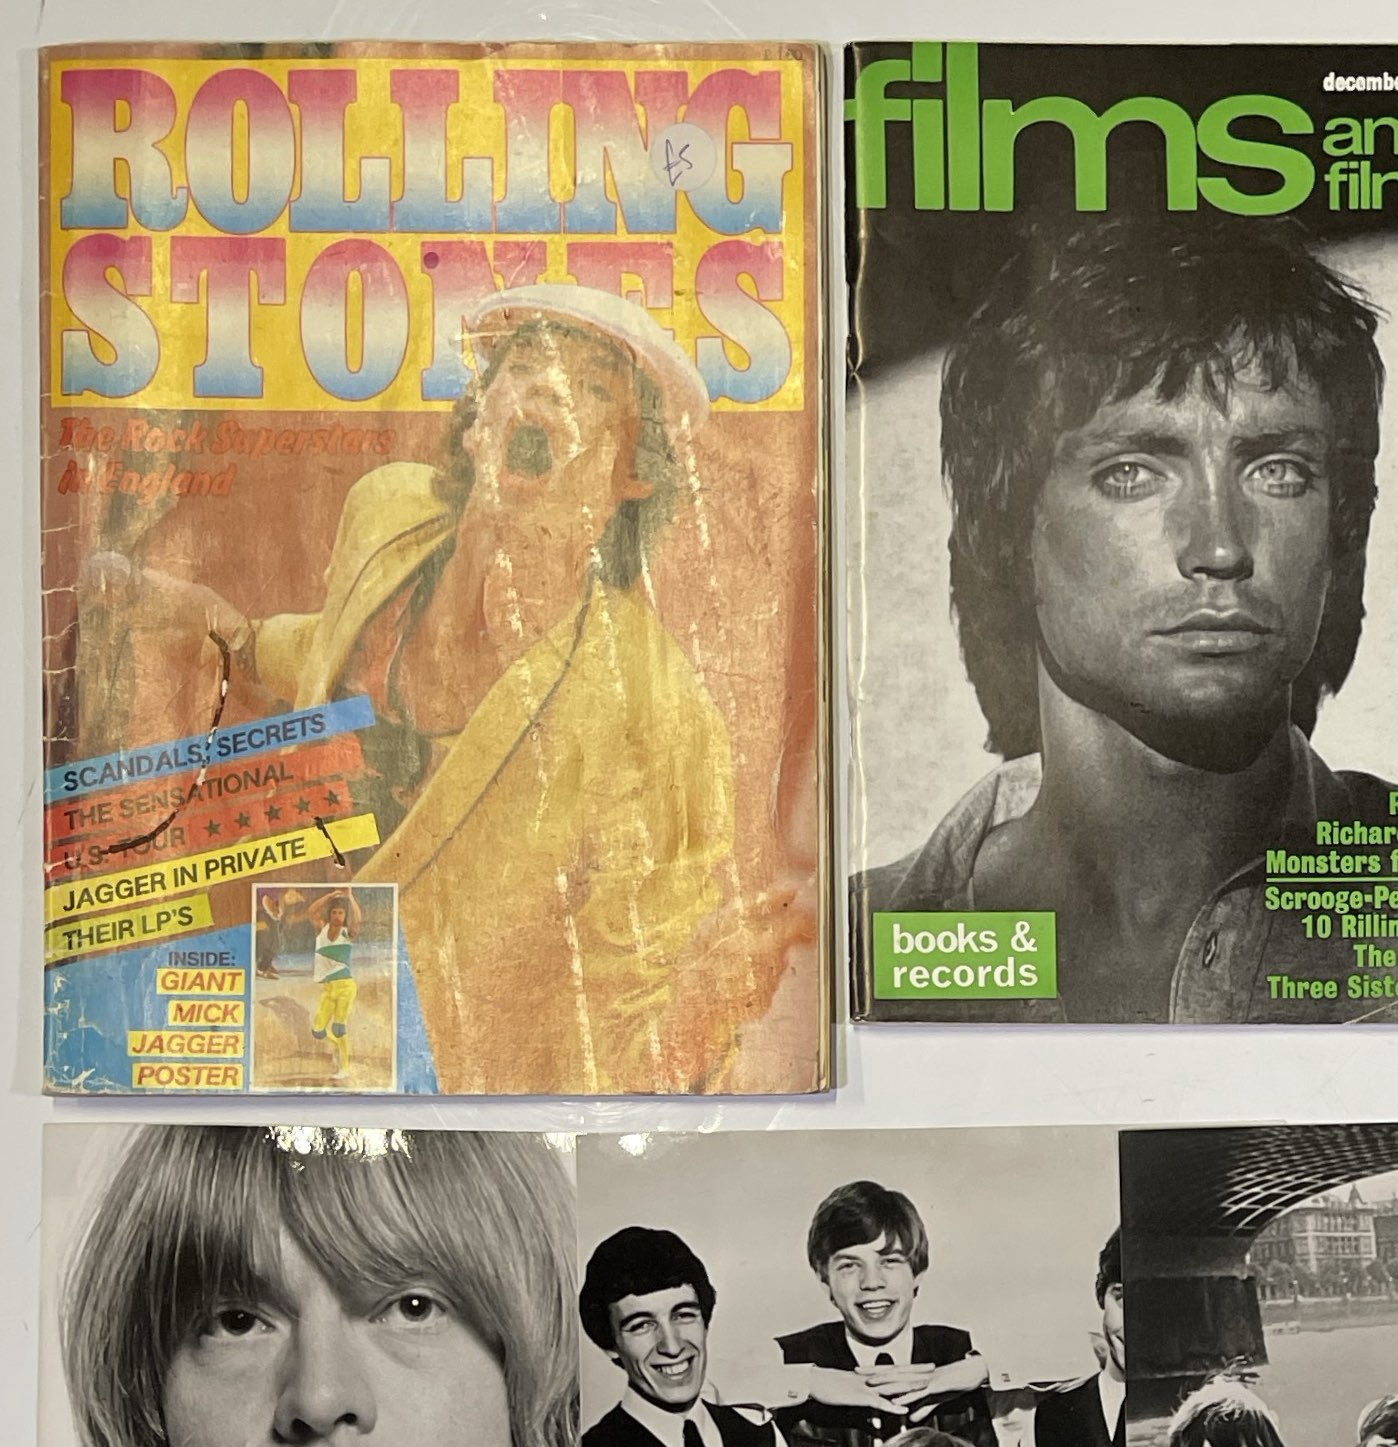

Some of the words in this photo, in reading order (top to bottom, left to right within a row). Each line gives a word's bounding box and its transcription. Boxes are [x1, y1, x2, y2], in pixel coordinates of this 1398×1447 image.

[844, 40, 1316, 216] films
[60, 67, 794, 236] ROLLING
[58, 417, 114, 450] The
[121, 418, 207, 454] Rock
[98, 462, 238, 506] England
[216, 713, 326, 758] SECRETS
[64, 802, 114, 830] THE
[120, 760, 294, 818] SENSATIONAL
[63, 871, 166, 912] JAGGER
[173, 863, 198, 888] IN
[205, 836, 307, 881] PRIVATE
[1266, 849, 1381, 873] Monsters
[62, 920, 134, 952] THEIR
[141, 906, 194, 936] LP'S
[893, 923, 998, 954] books
[1010, 921, 1037, 952] &
[1301, 914, 1332, 938] 10
[168, 951, 236, 966] INSIDE:
[1353, 944, 1397, 967] The
[161, 971, 242, 991] GIANT
[893, 956, 1038, 988] records
[1266, 976, 1338, 999] Three
[173, 1003, 241, 1023] MICK
[132, 1034, 240, 1055] JAGGER
[136, 1065, 240, 1085] POSTER
